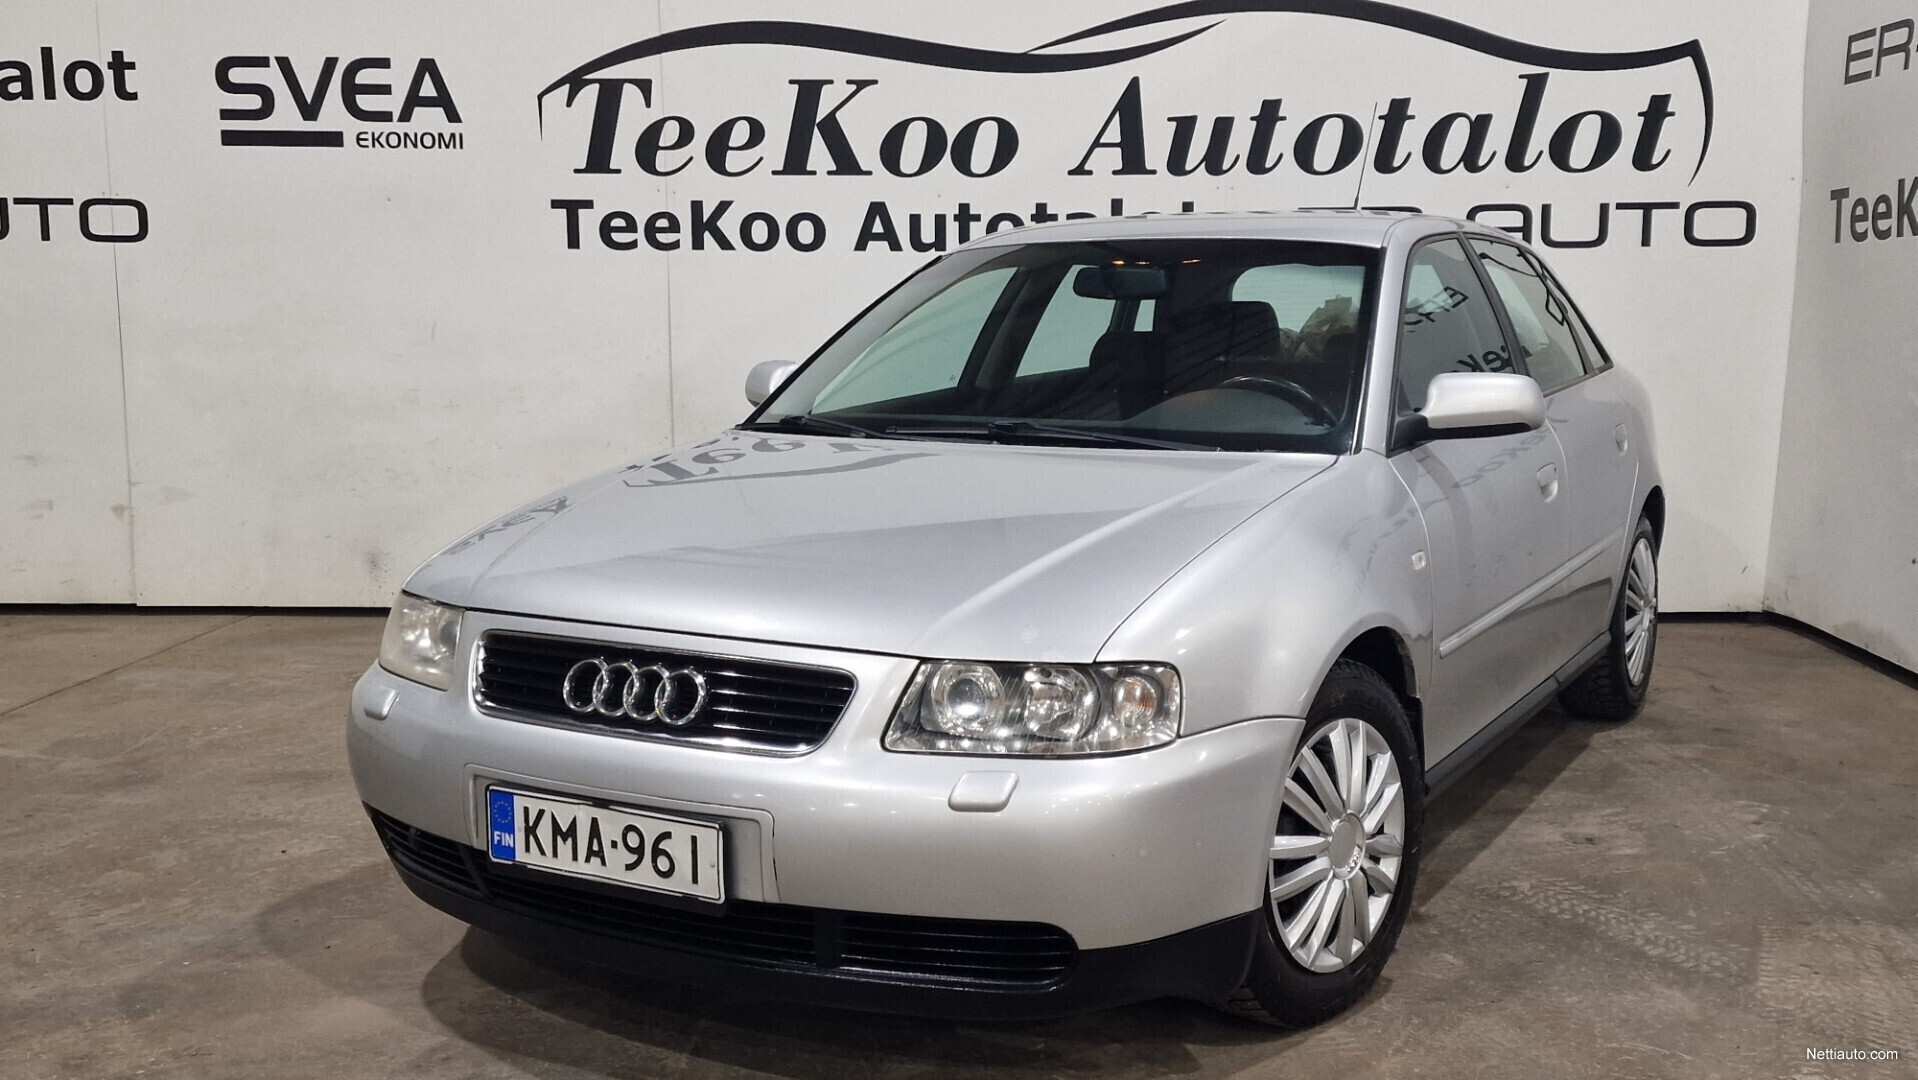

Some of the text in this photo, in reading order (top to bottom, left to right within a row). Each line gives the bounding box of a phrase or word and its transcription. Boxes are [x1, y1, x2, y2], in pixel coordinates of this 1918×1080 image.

[1843, 18, 1918, 86] ER
[214, 56, 463, 124] SVEA
[355, 131, 464, 150] EKONOMI
[565, 71, 1676, 178] TeeKoo Autotalot
[0, 197, 149, 243] TO
[550, 199, 828, 254] TeeKoo
[493, 830, 515, 848] FIN
[522, 805, 700, 886] KMA-961
